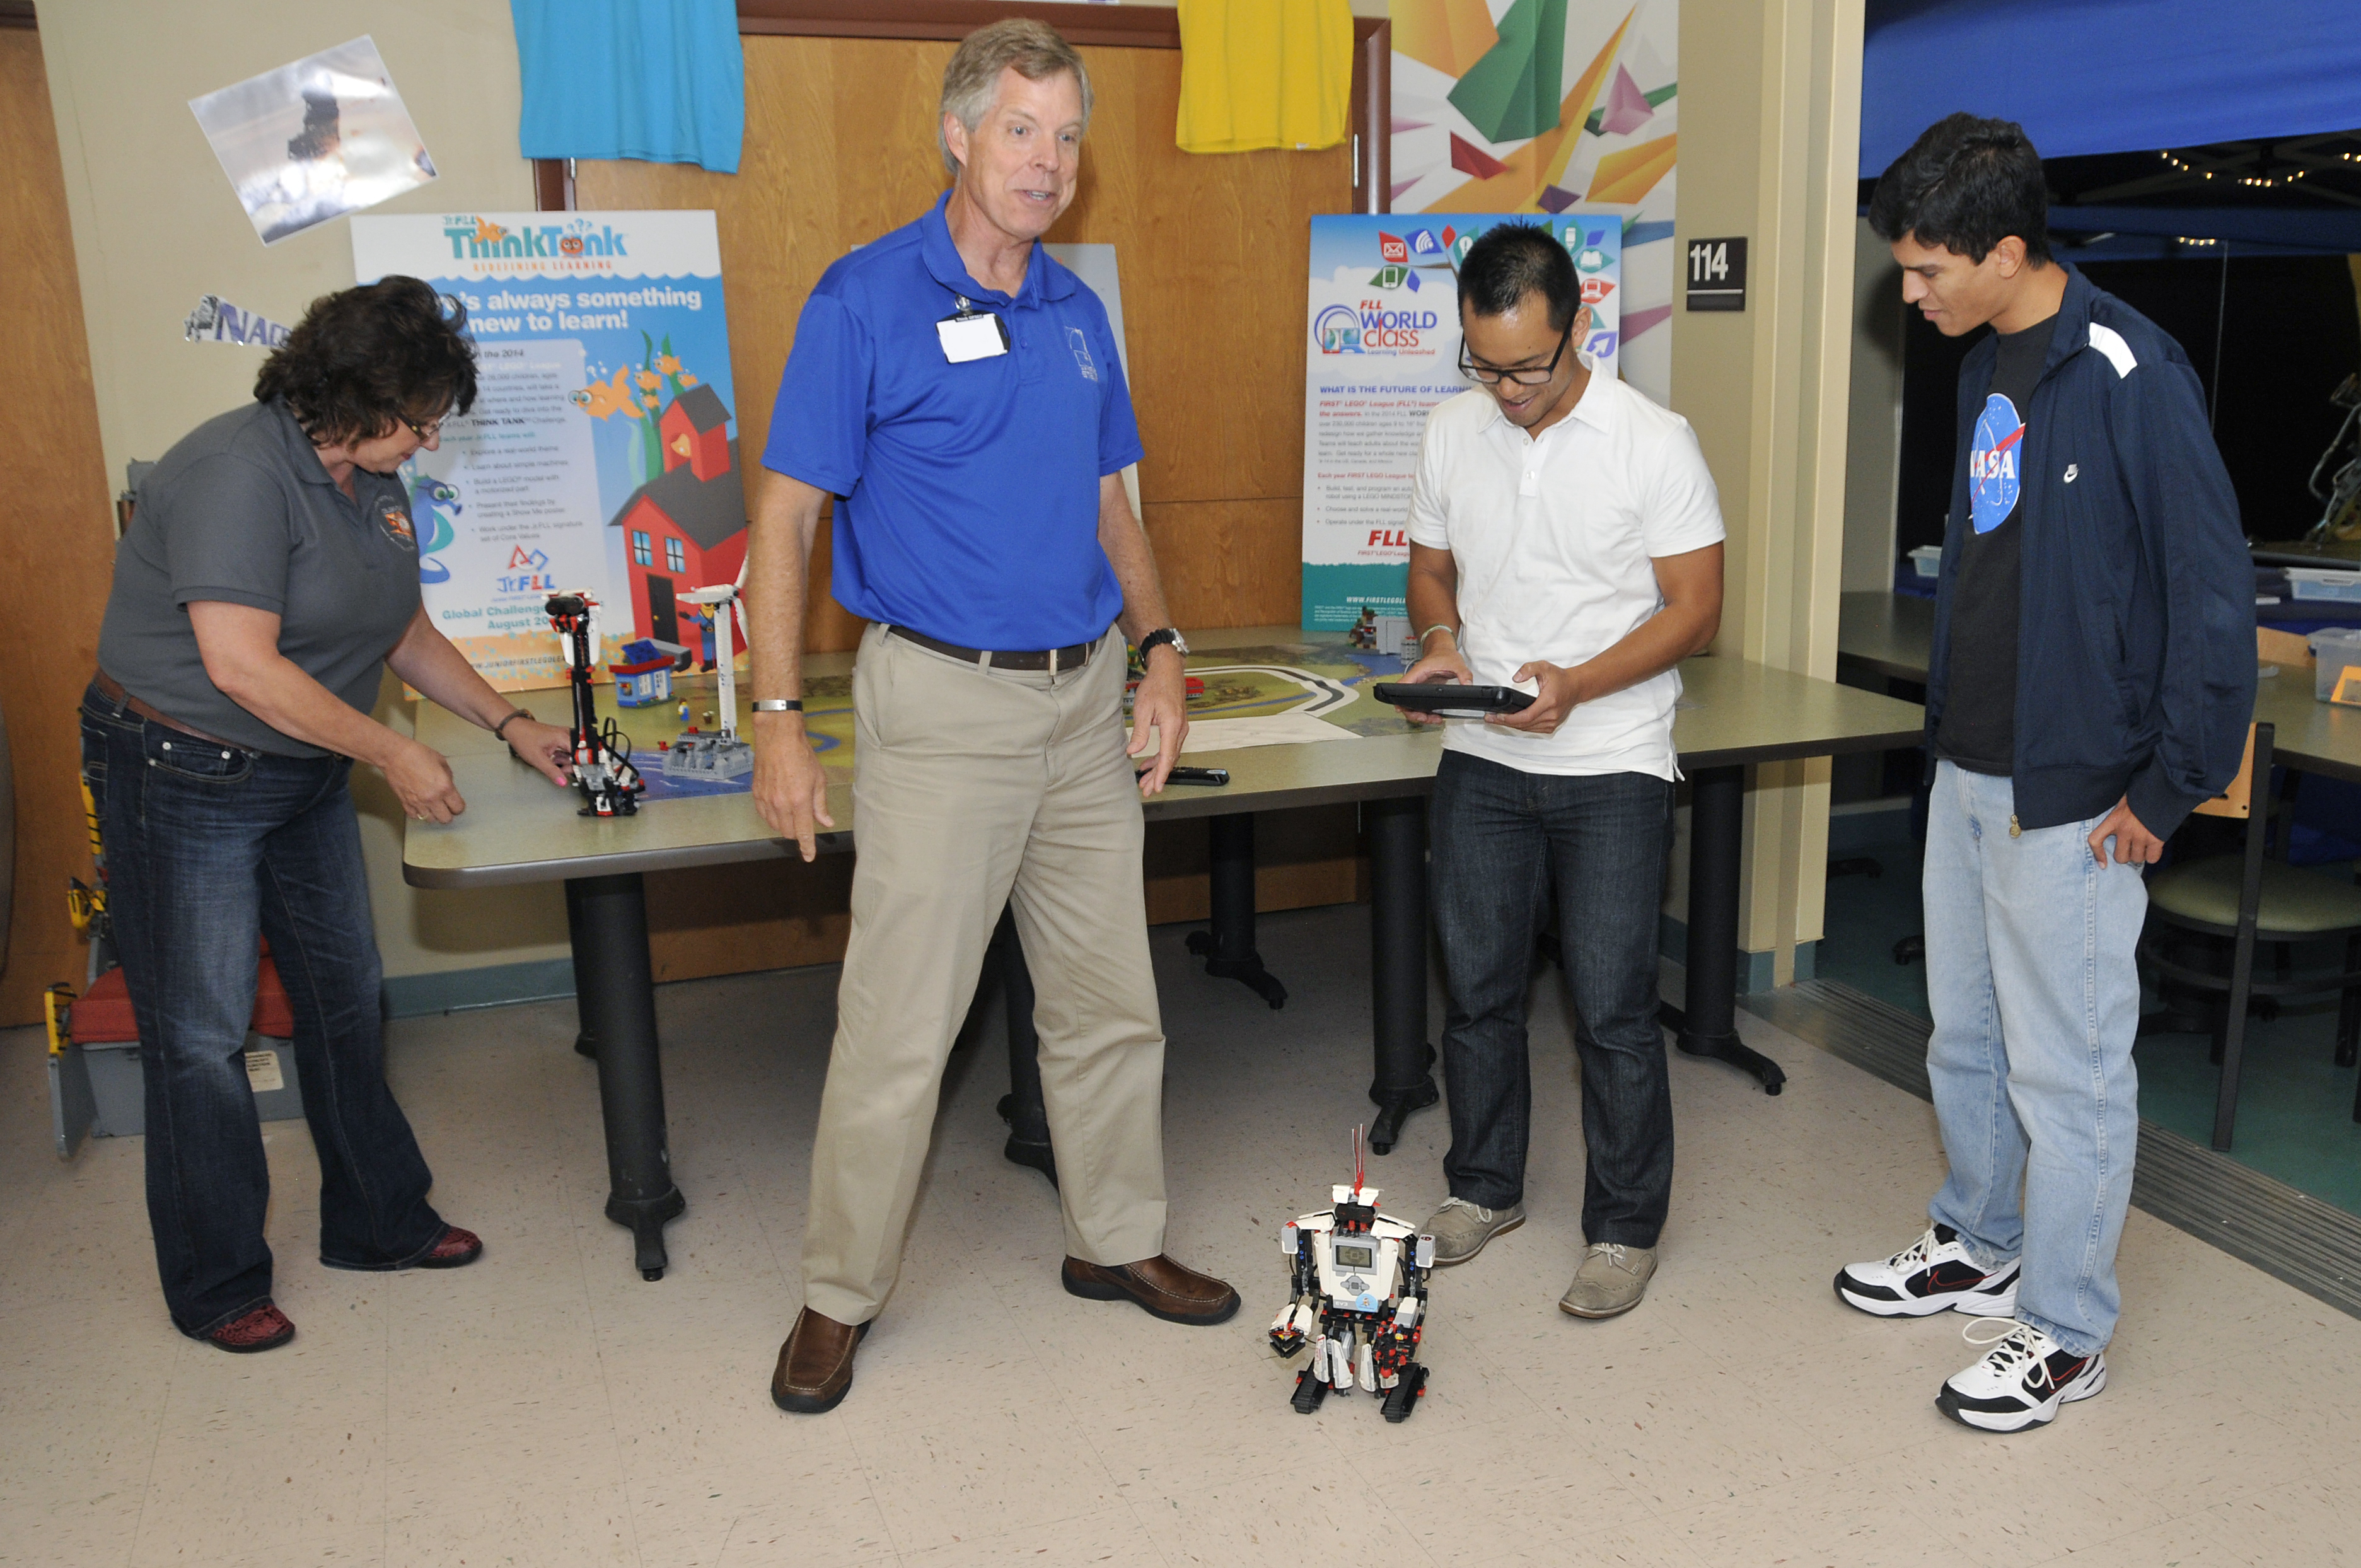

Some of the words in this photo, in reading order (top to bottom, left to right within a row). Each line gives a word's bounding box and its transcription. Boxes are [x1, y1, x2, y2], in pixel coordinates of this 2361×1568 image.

[552, 260, 612, 271] LEARNING
[1690, 242, 1729, 281] 114
[487, 289, 571, 313] always
[576, 286, 702, 311] something
[1360, 299, 1383, 310] FLL
[468, 316, 521, 334] new
[526, 312, 553, 332] to
[558, 309, 629, 332] learn!
[1359, 310, 1437, 329] WORLD
[1364, 318, 1419, 347] class
[1320, 385, 1345, 393] WHAT
[472, 418, 499, 427] THINK
[1970, 450, 2016, 479] NASA
[1367, 530, 1408, 547] FLL
[442, 608, 482, 620] Global
[486, 603, 547, 616] Challenge
[487, 617, 531, 630] August
[532, 615, 549, 626] 20
